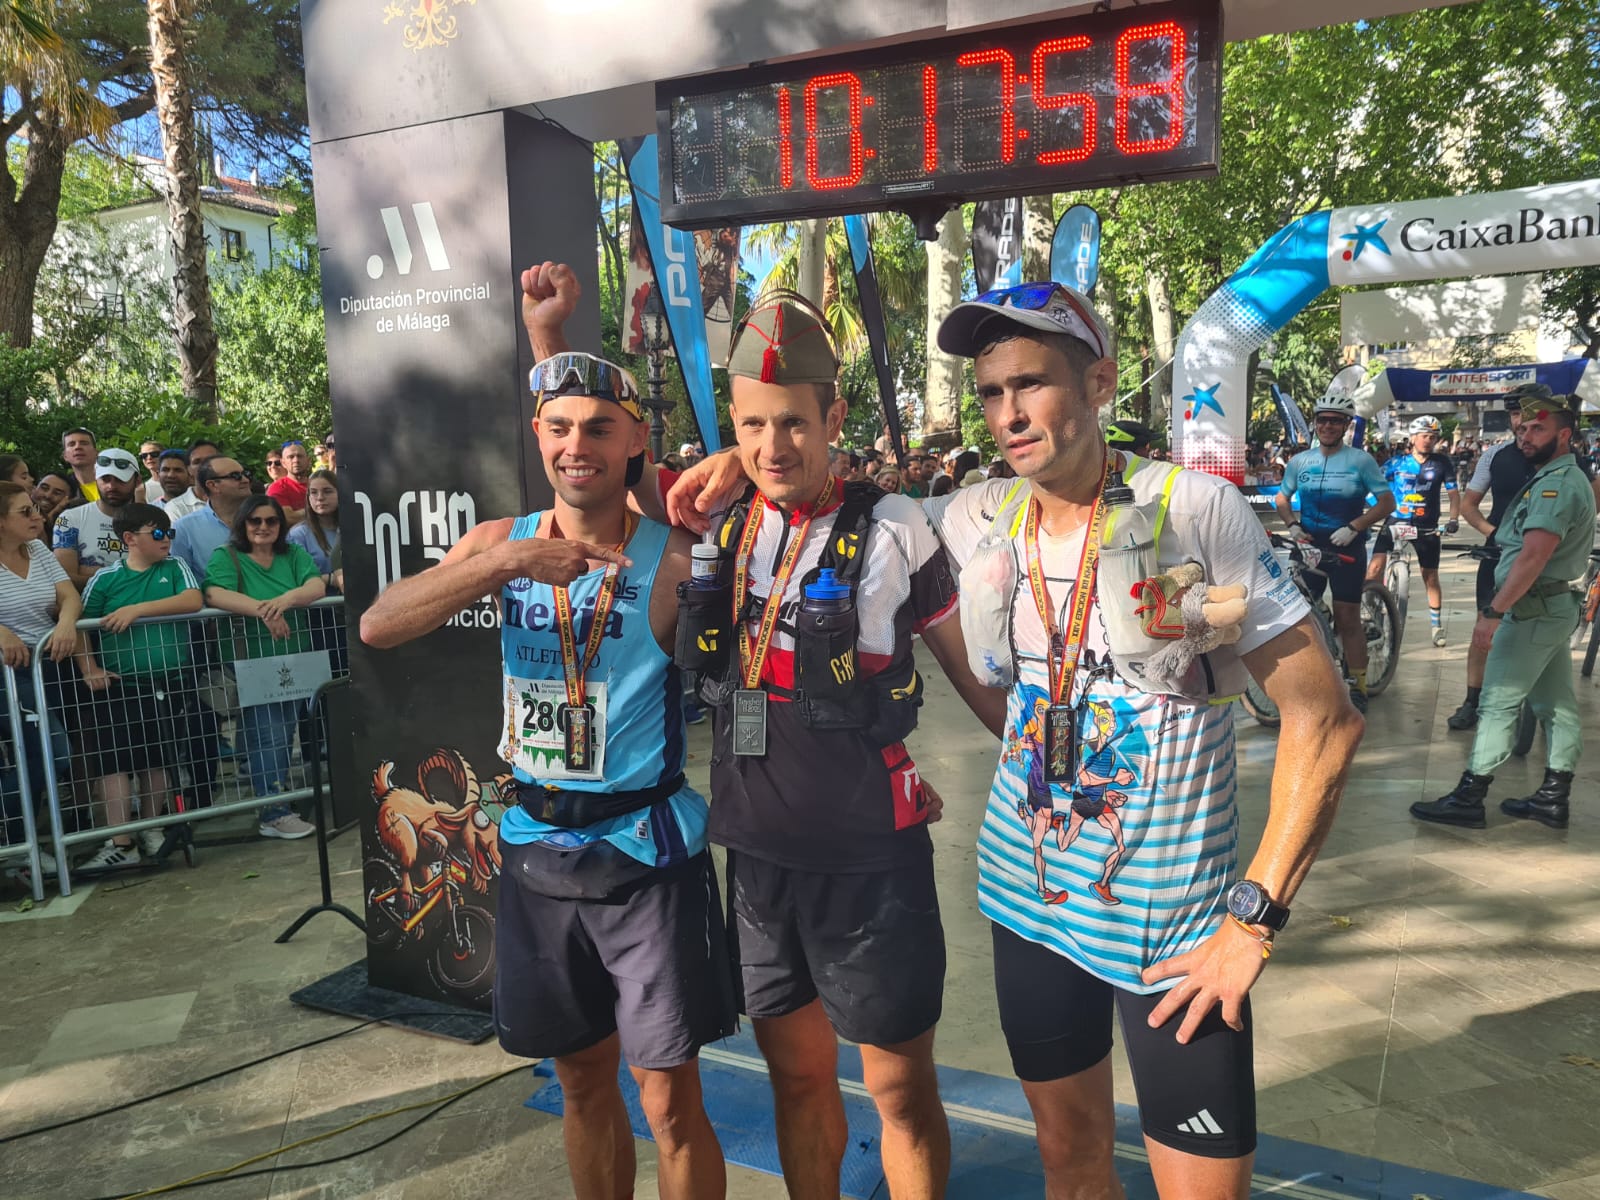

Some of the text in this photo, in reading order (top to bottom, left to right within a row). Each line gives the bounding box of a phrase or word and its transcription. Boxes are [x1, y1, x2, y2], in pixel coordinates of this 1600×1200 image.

[780, 21, 1185, 190] 10:17:58
[340, 282, 490, 316] Diputación Provincial
[376, 312, 450, 333] de Málaga
[1448, 369, 1532, 384] INTERSPORT
[740, 541, 750, 555] UNE
[1083, 565, 1092, 578] KM
[752, 655, 761, 668] KM
[750, 667, 758, 676] 24
